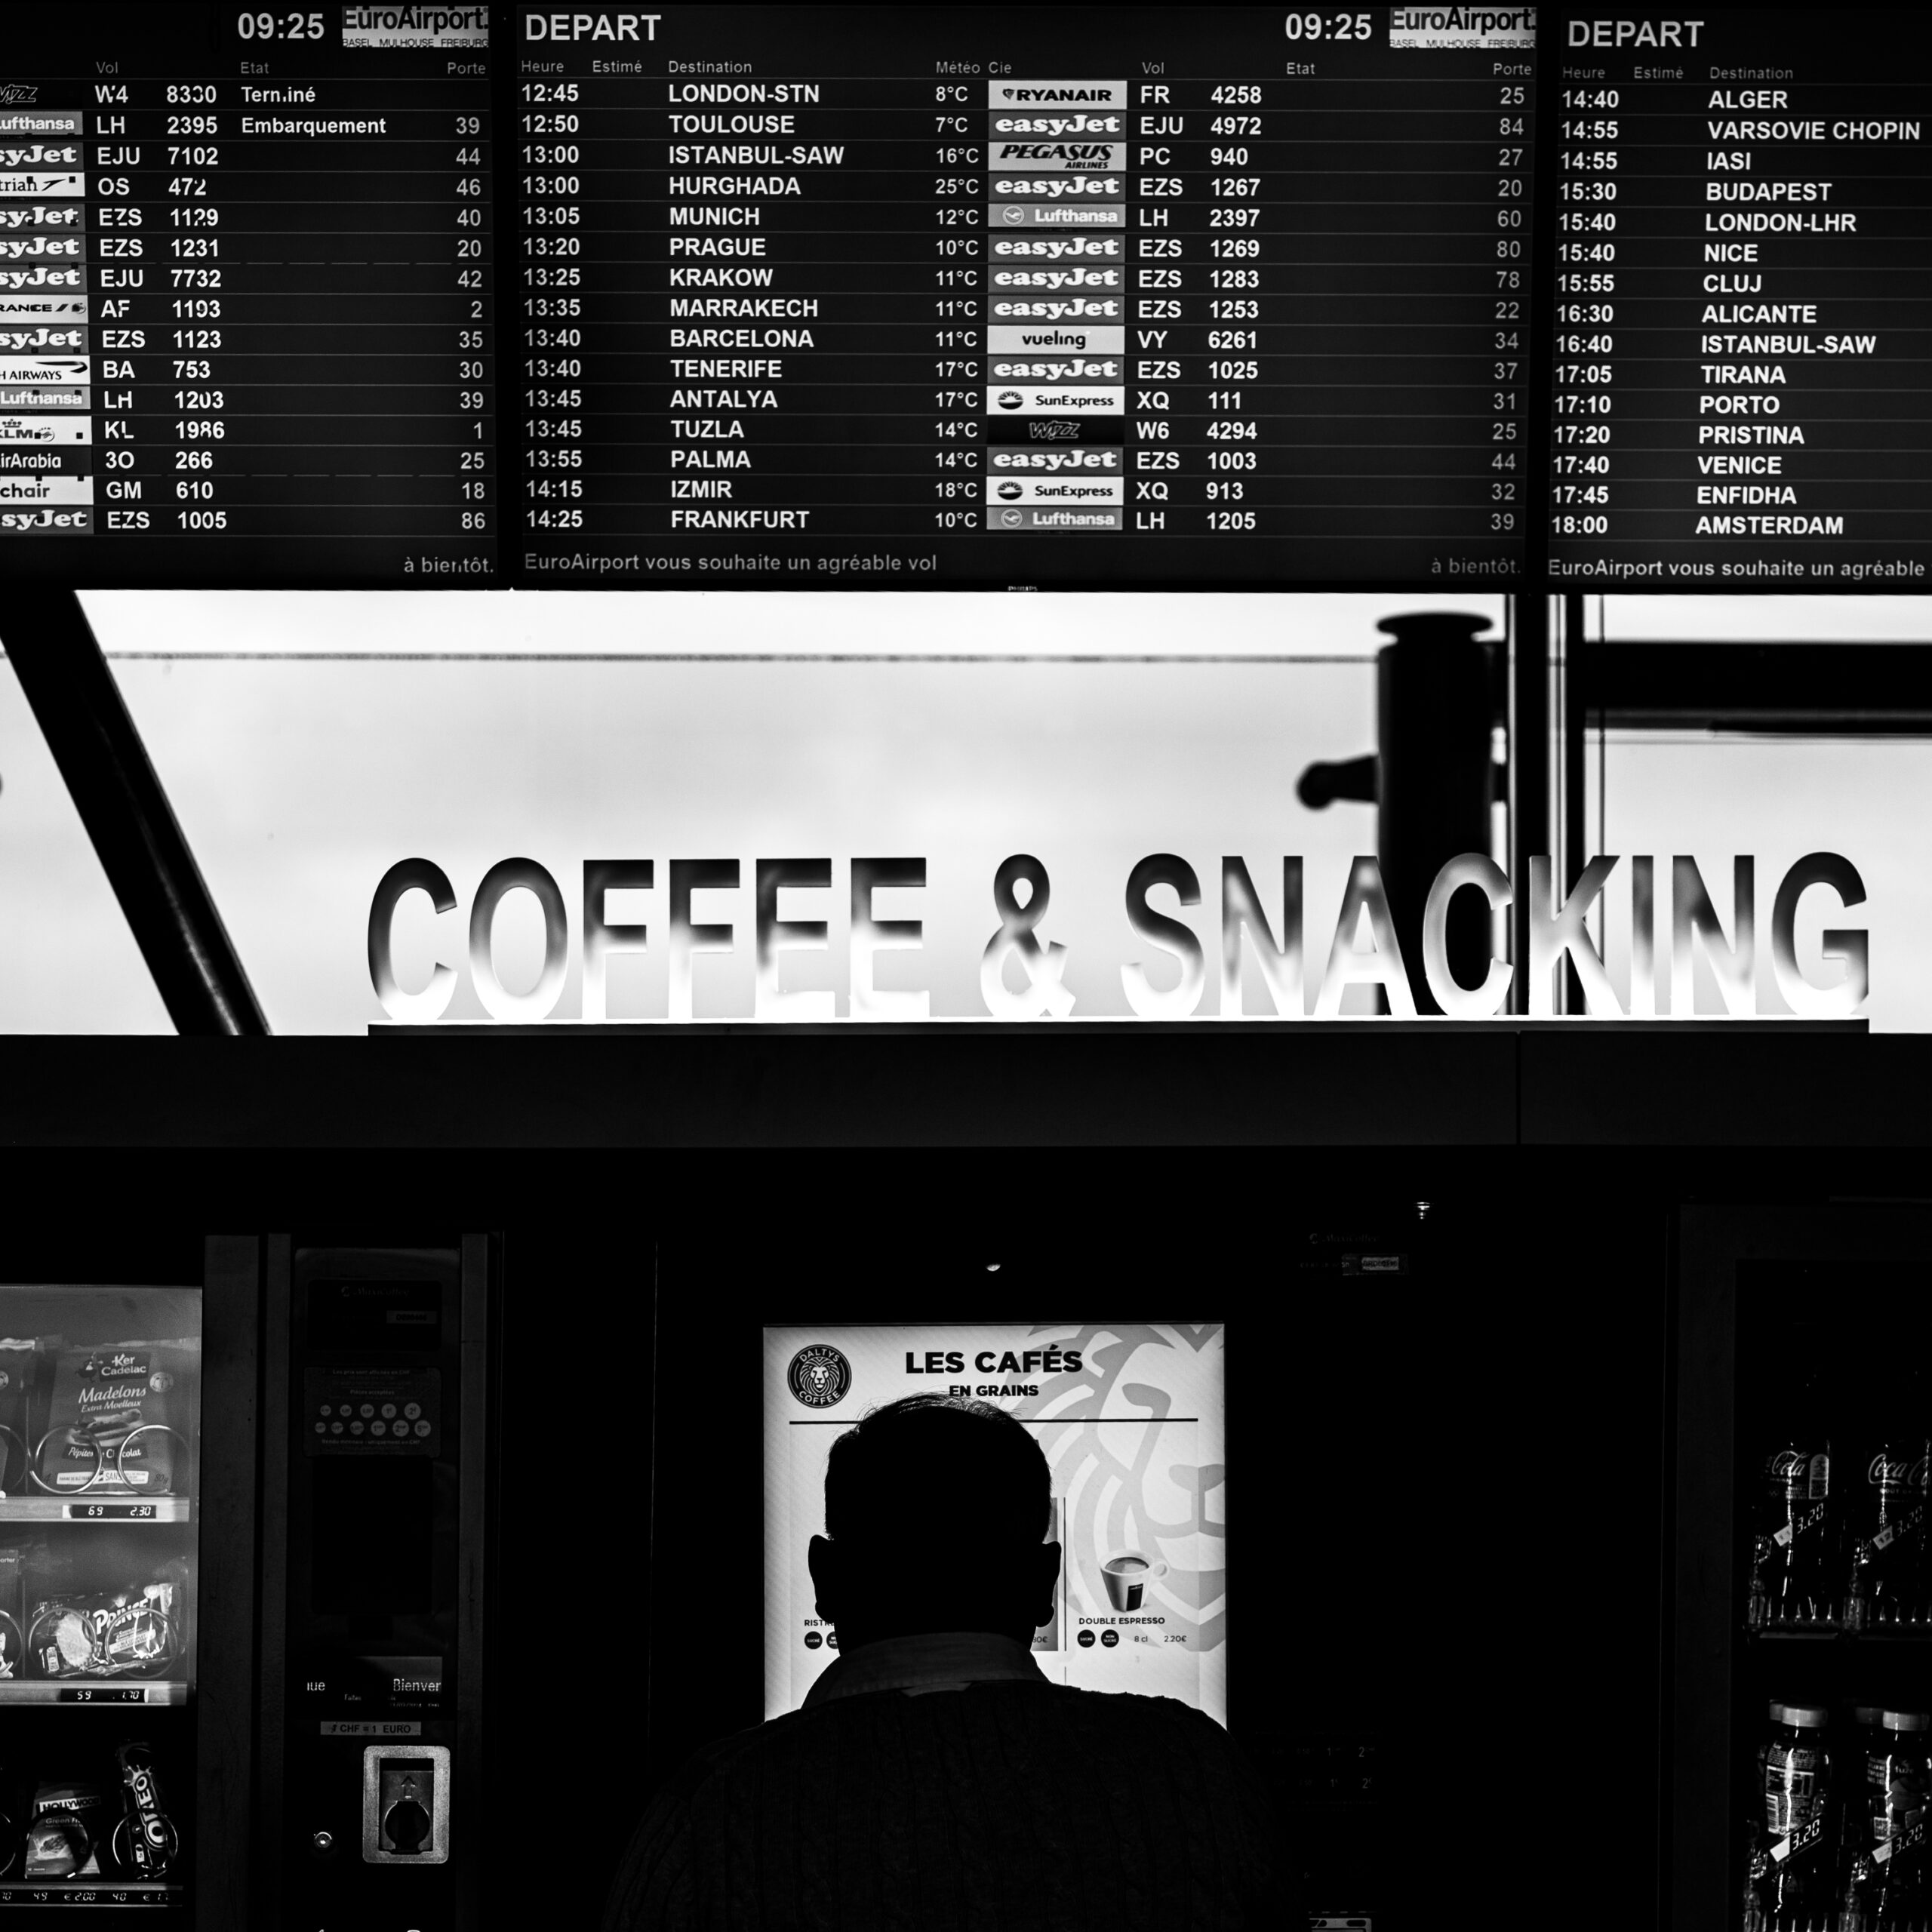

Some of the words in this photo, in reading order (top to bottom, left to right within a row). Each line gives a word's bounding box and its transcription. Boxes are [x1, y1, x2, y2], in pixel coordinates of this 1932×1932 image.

[238, 13, 324, 39] 09:25
[526, 14, 661, 41] DEPART
[1286, 14, 1371, 40] 09:25
[1568, 21, 1704, 47] DEPART
[97, 62, 118, 74] Vol
[241, 62, 269, 74] Etat
[448, 63, 486, 75] Porte
[521, 60, 564, 72] Heure
[592, 60, 641, 72] Estimé
[669, 60, 752, 72] Destination
[937, 61, 980, 73] Météo
[989, 62, 1012, 73] Cie
[1143, 62, 1164, 74] Vol
[1287, 63, 1315, 74] Etat
[1494, 63, 1532, 75] Porte
[95, 85, 128, 103] W4
[521, 84, 579, 101] 12:45
[669, 85, 820, 102] LONDON-STN
[936, 86, 968, 101] 8°C
[1015, 88, 1112, 102] RYANAIR
[1141, 86, 1171, 103] FR
[1211, 86, 1262, 103] 4258
[1500, 88, 1524, 104] 25
[1562, 91, 1619, 108] 14:40
[1709, 91, 1788, 109] ALGER
[97, 116, 125, 134] LH
[168, 116, 217, 134] 2395
[242, 117, 386, 137] Embarquement
[457, 117, 480, 134] 39
[1561, 122, 1618, 139] 14:55
[1708, 122, 1826, 140] VARSOVIE
[1832, 122, 1920, 140] CHOPIN
[522, 146, 579, 163] 13:00
[669, 146, 844, 164] ISTANBUL-SAW
[936, 148, 979, 163] 16°C
[1000, 144, 1114, 162] PEGASUS
[1065, 161, 1109, 170] AIRLINES
[1140, 147, 1171, 165] PC
[1211, 147, 1248, 165] 940
[1500, 149, 1523, 165] 27
[523, 208, 580, 225] 13:05
[669, 208, 760, 225] MUNICH
[936, 209, 979, 225] 12°C
[1035, 208, 1118, 223] Lufthansa
[1140, 209, 1168, 226] LH
[1210, 209, 1260, 226] 2397
[1498, 210, 1521, 226] 60
[1559, 214, 1617, 231] 15:40
[1706, 214, 1857, 232] LONDON-LHR
[525, 299, 581, 316] 13:35
[670, 299, 818, 317] MARRAKECH
[935, 301, 977, 316] 11°C
[995, 298, 1118, 320] easyJet
[1139, 300, 1182, 318] EZS
[1209, 300, 1260, 318] 1253
[1495, 302, 1519, 318] 22
[103, 331, 146, 348] EZS
[173, 331, 222, 348] 1123
[459, 331, 483, 348] 35
[525, 329, 581, 346] 13:40
[670, 329, 814, 347] BARCELONA
[935, 331, 977, 346] 11°C
[1022, 331, 1086, 350] vueling
[1137, 331, 1168, 349] VY
[1208, 331, 1257, 349] 6261
[1495, 332, 1518, 349] 34
[1556, 335, 1613, 352] 16:40
[1701, 335, 1877, 353] ISTANBUL-SAW
[525, 390, 582, 408] 13:45
[670, 390, 778, 408] ANTALYA
[935, 392, 978, 408] 17°C
[1035, 395, 1115, 408] SunExpress
[1137, 392, 1169, 410] XQ
[1208, 392, 1241, 409] 111
[1494, 393, 1515, 410] 31
[0, 483, 50, 498] chair
[106, 481, 142, 500] GM
[176, 481, 214, 499] 610
[462, 481, 485, 499] 18
[1552, 516, 1607, 534] 18:00
[1695, 516, 1844, 535] AMSTERDAM
[404, 557, 414, 573] à
[525, 554, 639, 574] EuroAirport
[646, 558, 691, 570] vous
[698, 554, 780, 571] souhaite
[788, 558, 810, 570] un
[817, 555, 902, 574] agréable
[908, 555, 937, 571] vol
[368, 857, 929, 1022] COFFEE
[982, 854, 1070, 1021] &
[1122, 853, 1871, 1021] SNACKING
[111, 1352, 136, 1367] Ker
[799, 1349, 840, 1362] DALTYS
[906, 1352, 965, 1374] LES
[974, 1344, 1083, 1374] CAFÉS
[101, 1365, 147, 1376] Cadelac
[78, 1385, 147, 1404] Madelons
[799, 1391, 841, 1404] COFFEE
[949, 1385, 971, 1397] EN
[976, 1384, 1039, 1397] GRAINS
[81, 1404, 103, 1414] Extra
[103, 1399, 142, 1411] Moelleux
[88, 1506, 104, 1516] 69
[130, 1506, 152, 1517] 2.30
[1796, 1502, 1824, 1534] 3.20
[1897, 1506, 1924, 1537] 3.20
[1878, 1532, 1892, 1545] 12
[1118, 1617, 1166, 1625] ESPRESSO
[393, 1678, 441, 1691] Bienver
[340, 1724, 361, 1733] CHF
[372, 1724, 377, 1734] 1
[383, 1724, 411, 1734] EURO
[1792, 1819, 1821, 1851] 3.20
[1894, 1823, 1924, 1856] 3.20
